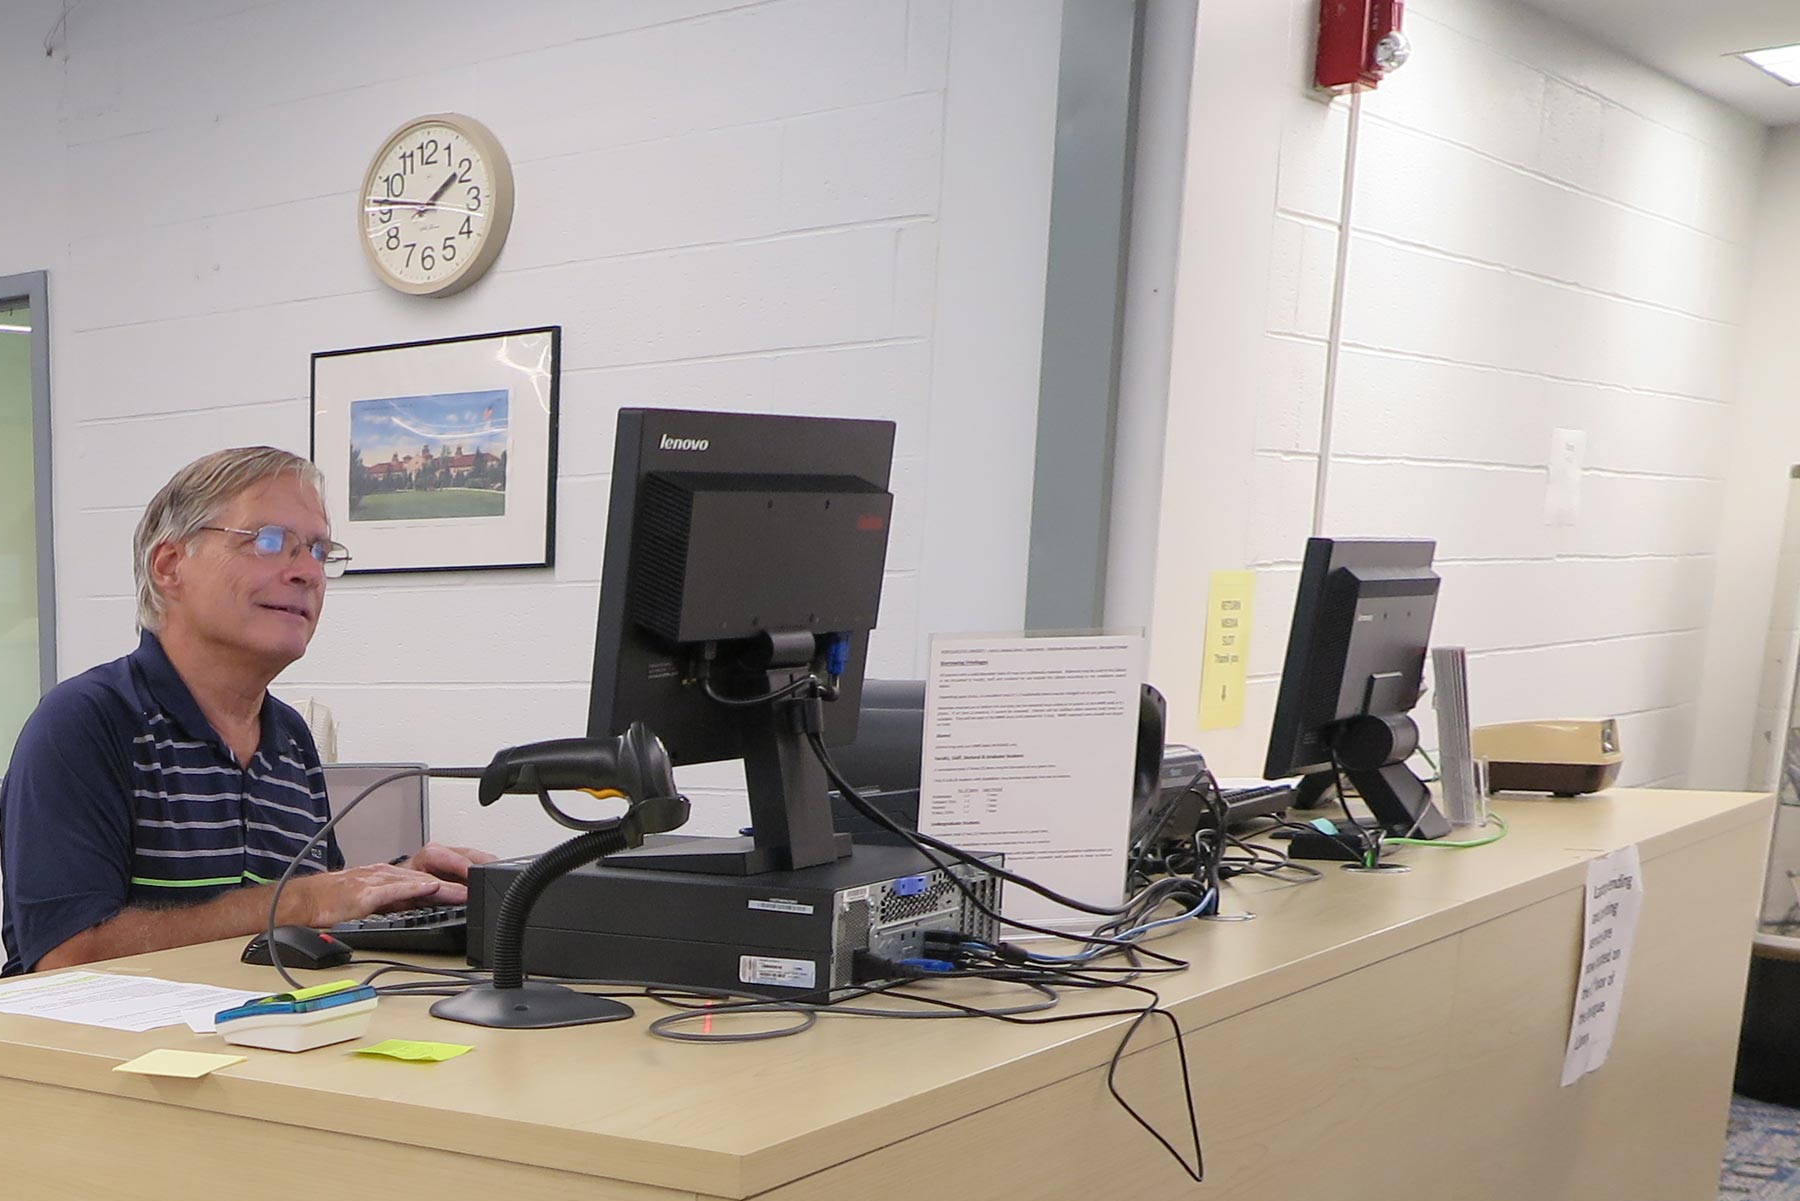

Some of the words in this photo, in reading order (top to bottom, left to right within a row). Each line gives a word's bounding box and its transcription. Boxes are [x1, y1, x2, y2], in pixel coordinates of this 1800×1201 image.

[399, 150, 414, 175] 11
[416, 139, 439, 166] 12
[443, 143, 452, 167] 1
[458, 158, 472, 183] 2
[382, 173, 405, 198] 10
[466, 186, 481, 211] 3
[386, 226, 400, 251] 8
[458, 215, 473, 239] 4
[403, 243, 416, 268] 7
[421, 246, 435, 271] 6
[442, 237, 456, 261] 5
[660, 433, 709, 451] lenovo
